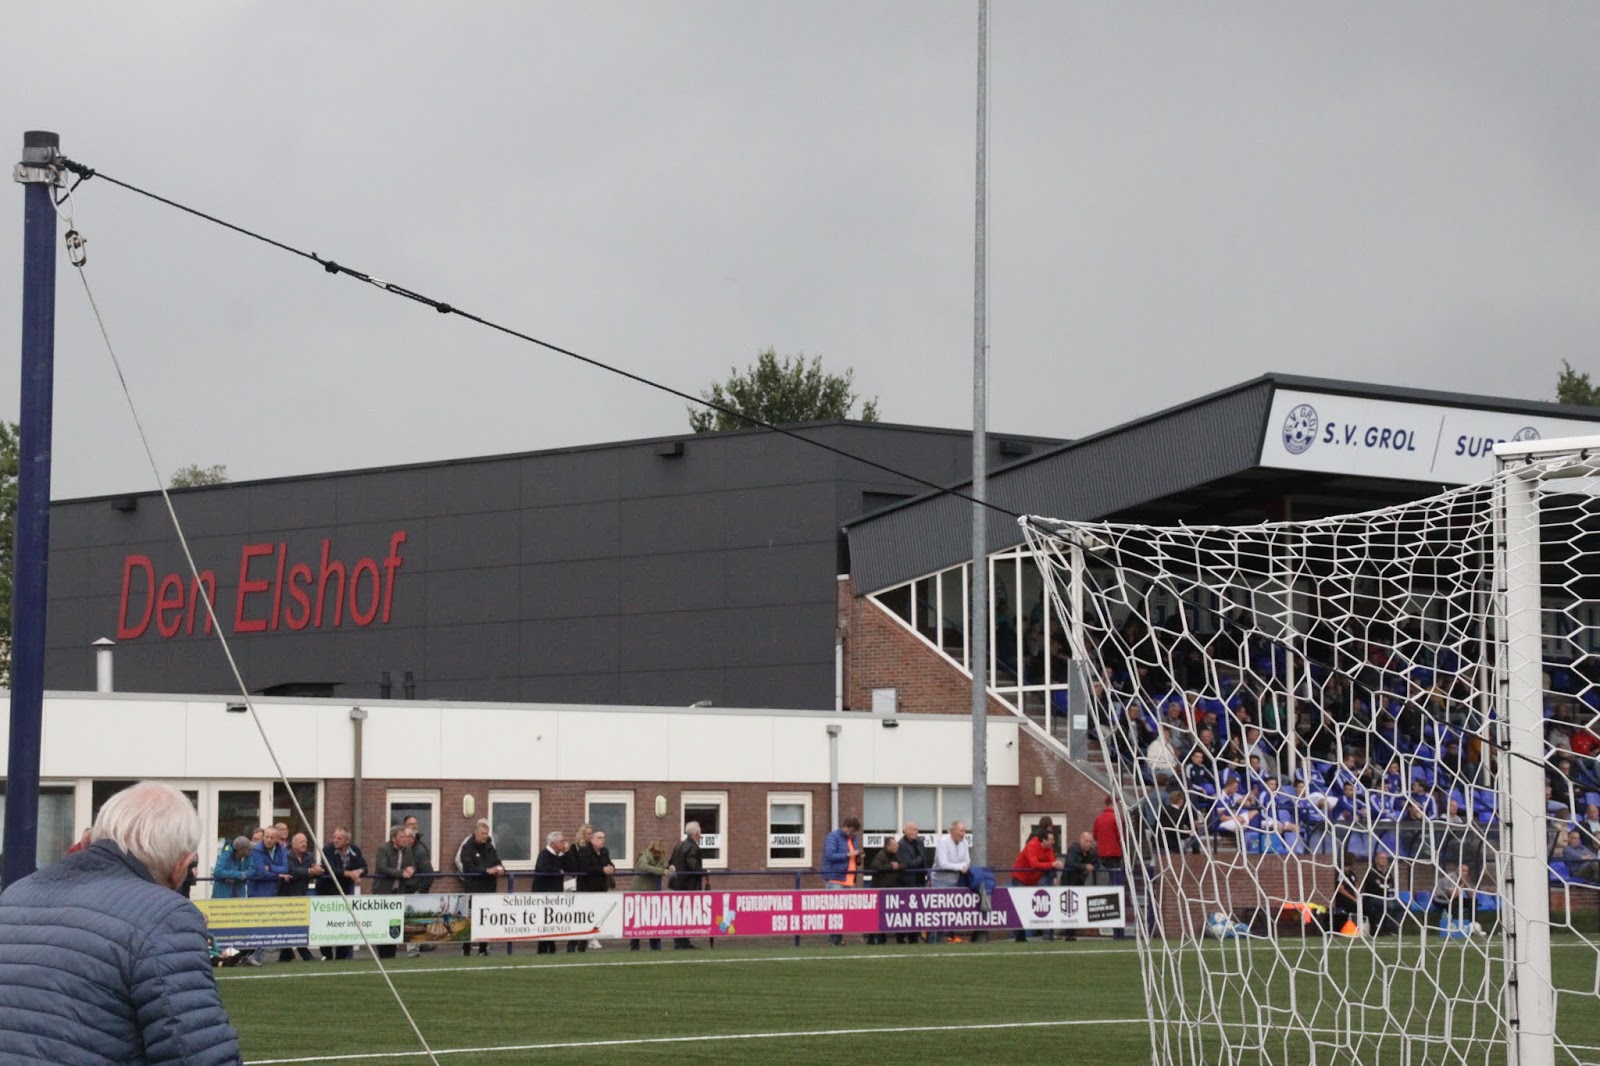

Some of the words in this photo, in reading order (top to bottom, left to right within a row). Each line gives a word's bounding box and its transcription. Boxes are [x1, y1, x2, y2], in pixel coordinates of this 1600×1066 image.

[1323, 422, 1357, 446] S.V.
[1364, 427, 1416, 451] GROL
[1455, 435, 1506, 457] SUP
[117, 554, 217, 639] Den
[234, 531, 407, 632] Elshof
[352, 899, 402, 911] Kickbiken
[503, 895, 576, 907] Schildersbedrijf
[736, 895, 793, 911] PEUTEROPVANG
[886, 894, 905, 909] IN-
[909, 894, 918, 908] &
[479, 908, 517, 926] Fons
[523, 909, 537, 925] te
[544, 907, 595, 925] Boome
[624, 895, 712, 928] PINDAKAAS
[886, 912, 913, 927] VAN
[915, 910, 1007, 926] RESTPARTIJEN
[327, 920, 346, 928] Meer
[346, 920, 361, 928] in
[504, 926, 531, 934] MEDDO
[537, 925, 571, 933] GROENLO
[772, 915, 788, 931] BSO
[790, 914, 800, 931] EN
[802, 914, 826, 930] SPORT
[828, 913, 844, 930] BSO
